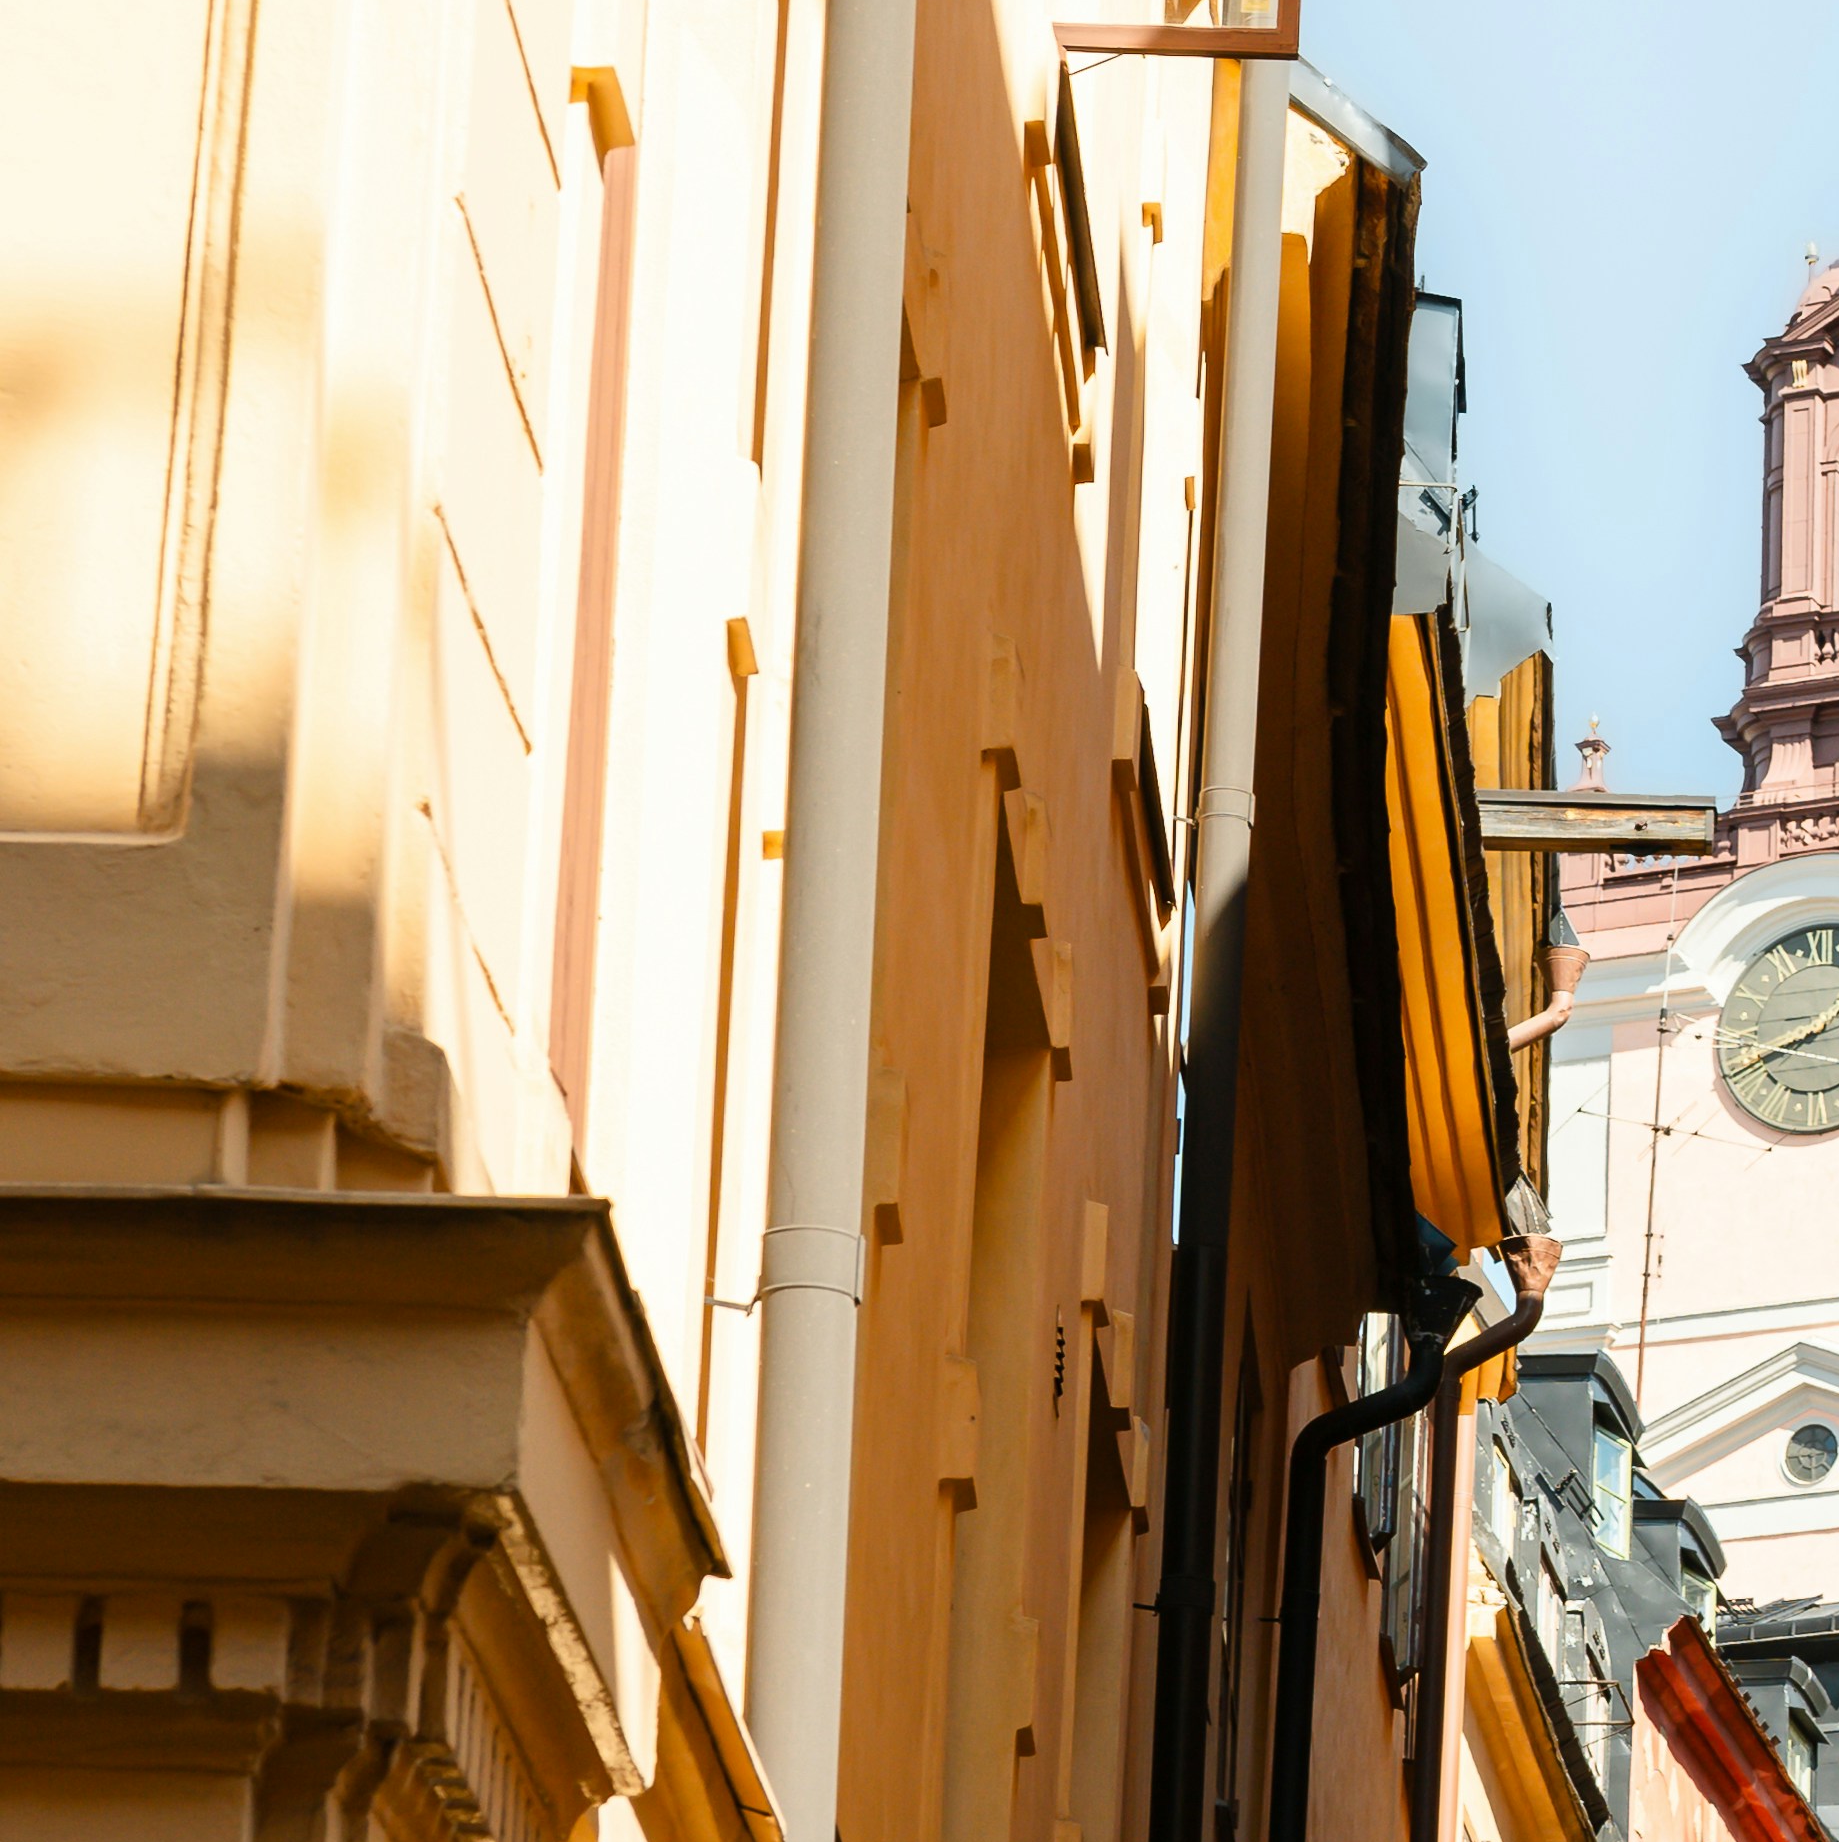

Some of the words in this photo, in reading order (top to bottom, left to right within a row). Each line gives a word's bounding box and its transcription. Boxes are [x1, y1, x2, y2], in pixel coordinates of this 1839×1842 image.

[1764, 943, 1798, 983] XI
[1805, 929, 1834, 966] XII
[1734, 983, 1768, 1009] X
